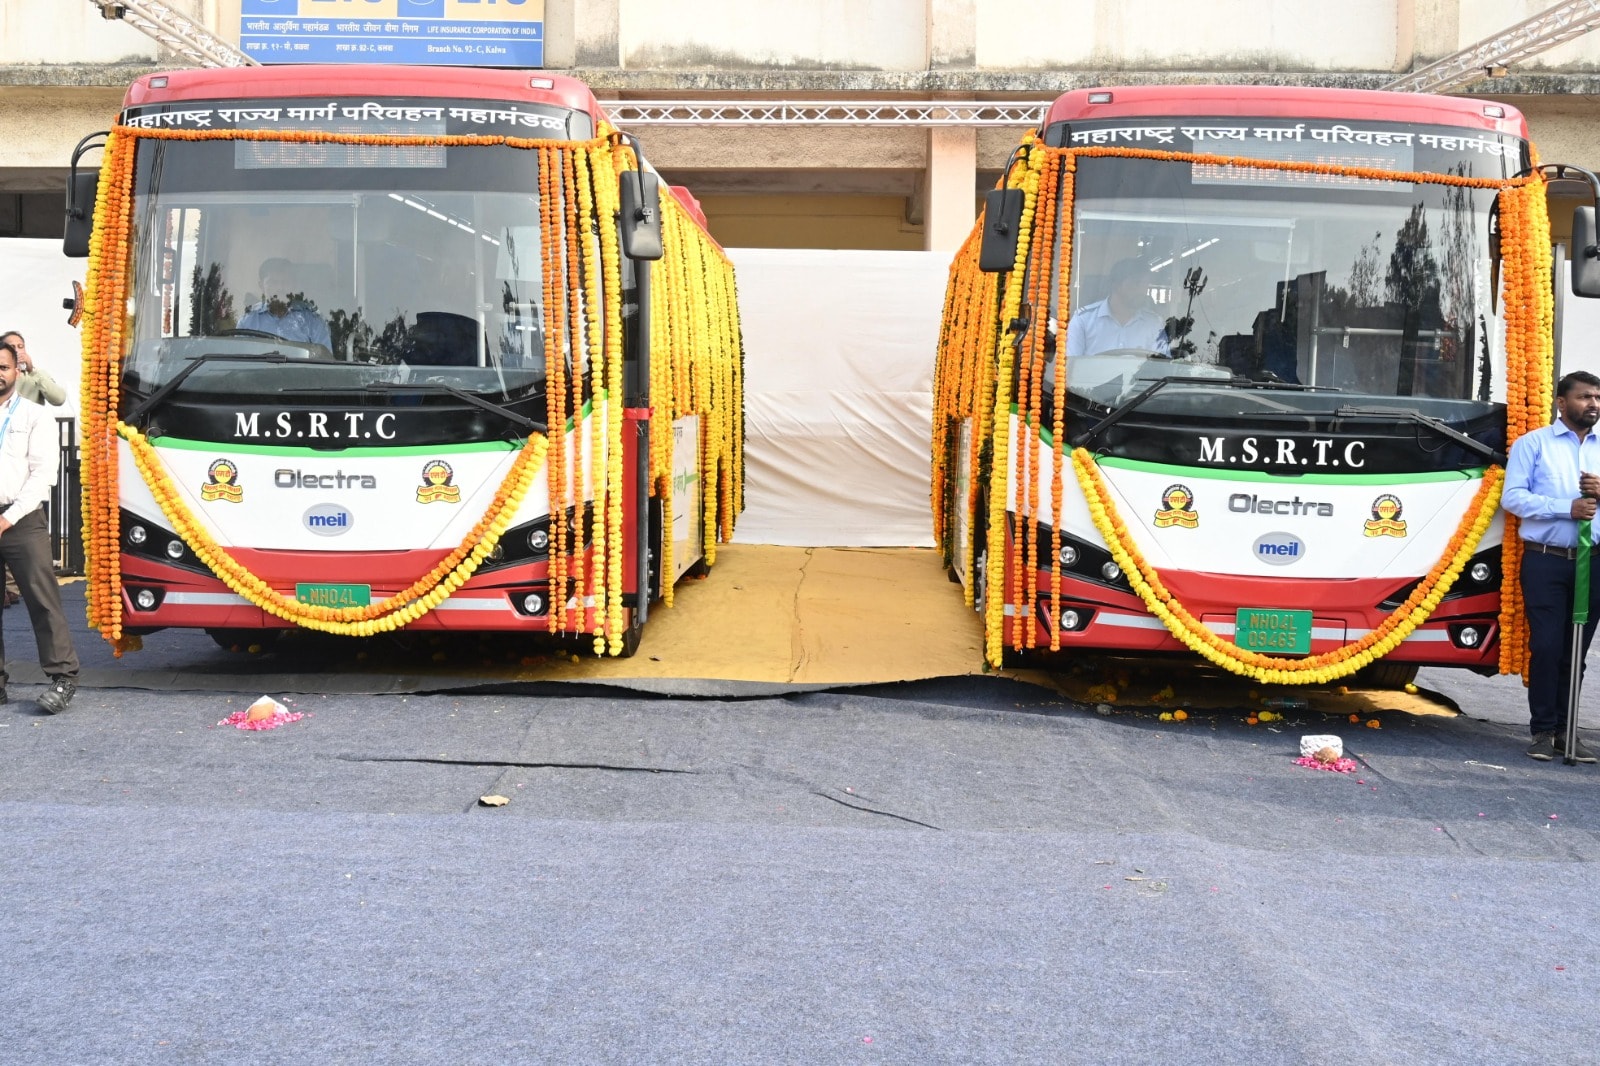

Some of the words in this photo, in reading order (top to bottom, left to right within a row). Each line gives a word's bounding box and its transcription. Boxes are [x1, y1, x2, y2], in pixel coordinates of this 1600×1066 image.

[336, 22, 360, 32] भारतीय
[363, 22, 381, 32] जीवन
[402, 22, 419, 32] निगम
[428, 26, 439, 34] LIFE
[440, 26, 472, 34] INSURANCE
[472, 26, 511, 35] CORPORATION
[428, 44, 451, 53] Branch
[452, 45, 463, 53] No.
[127, 110, 213, 128] महाराष्ट्र
[218, 108, 282, 122] राज्य
[287, 102, 338, 121] मार्ग
[342, 102, 445, 121] परिवहन
[449, 106, 565, 130] महामंडळ
[1071, 127, 1176, 144] महाराष्ट्र
[1181, 127, 1248, 141] राज्य
[1253, 124, 1305, 142] मार्ग
[1310, 125, 1415, 146] परिवहन
[1419, 134, 1520, 160] महामंडळ
[234, 412, 396, 439] M.S.R.T.C
[1198, 437, 1365, 468] M.S.R.T.C
[274, 469, 376, 488] Olectra
[1228, 493, 1334, 516] Olectra
[309, 513, 346, 526] meil
[1258, 542, 1298, 556] meil
[1250, 612, 1297, 631] MH04L
